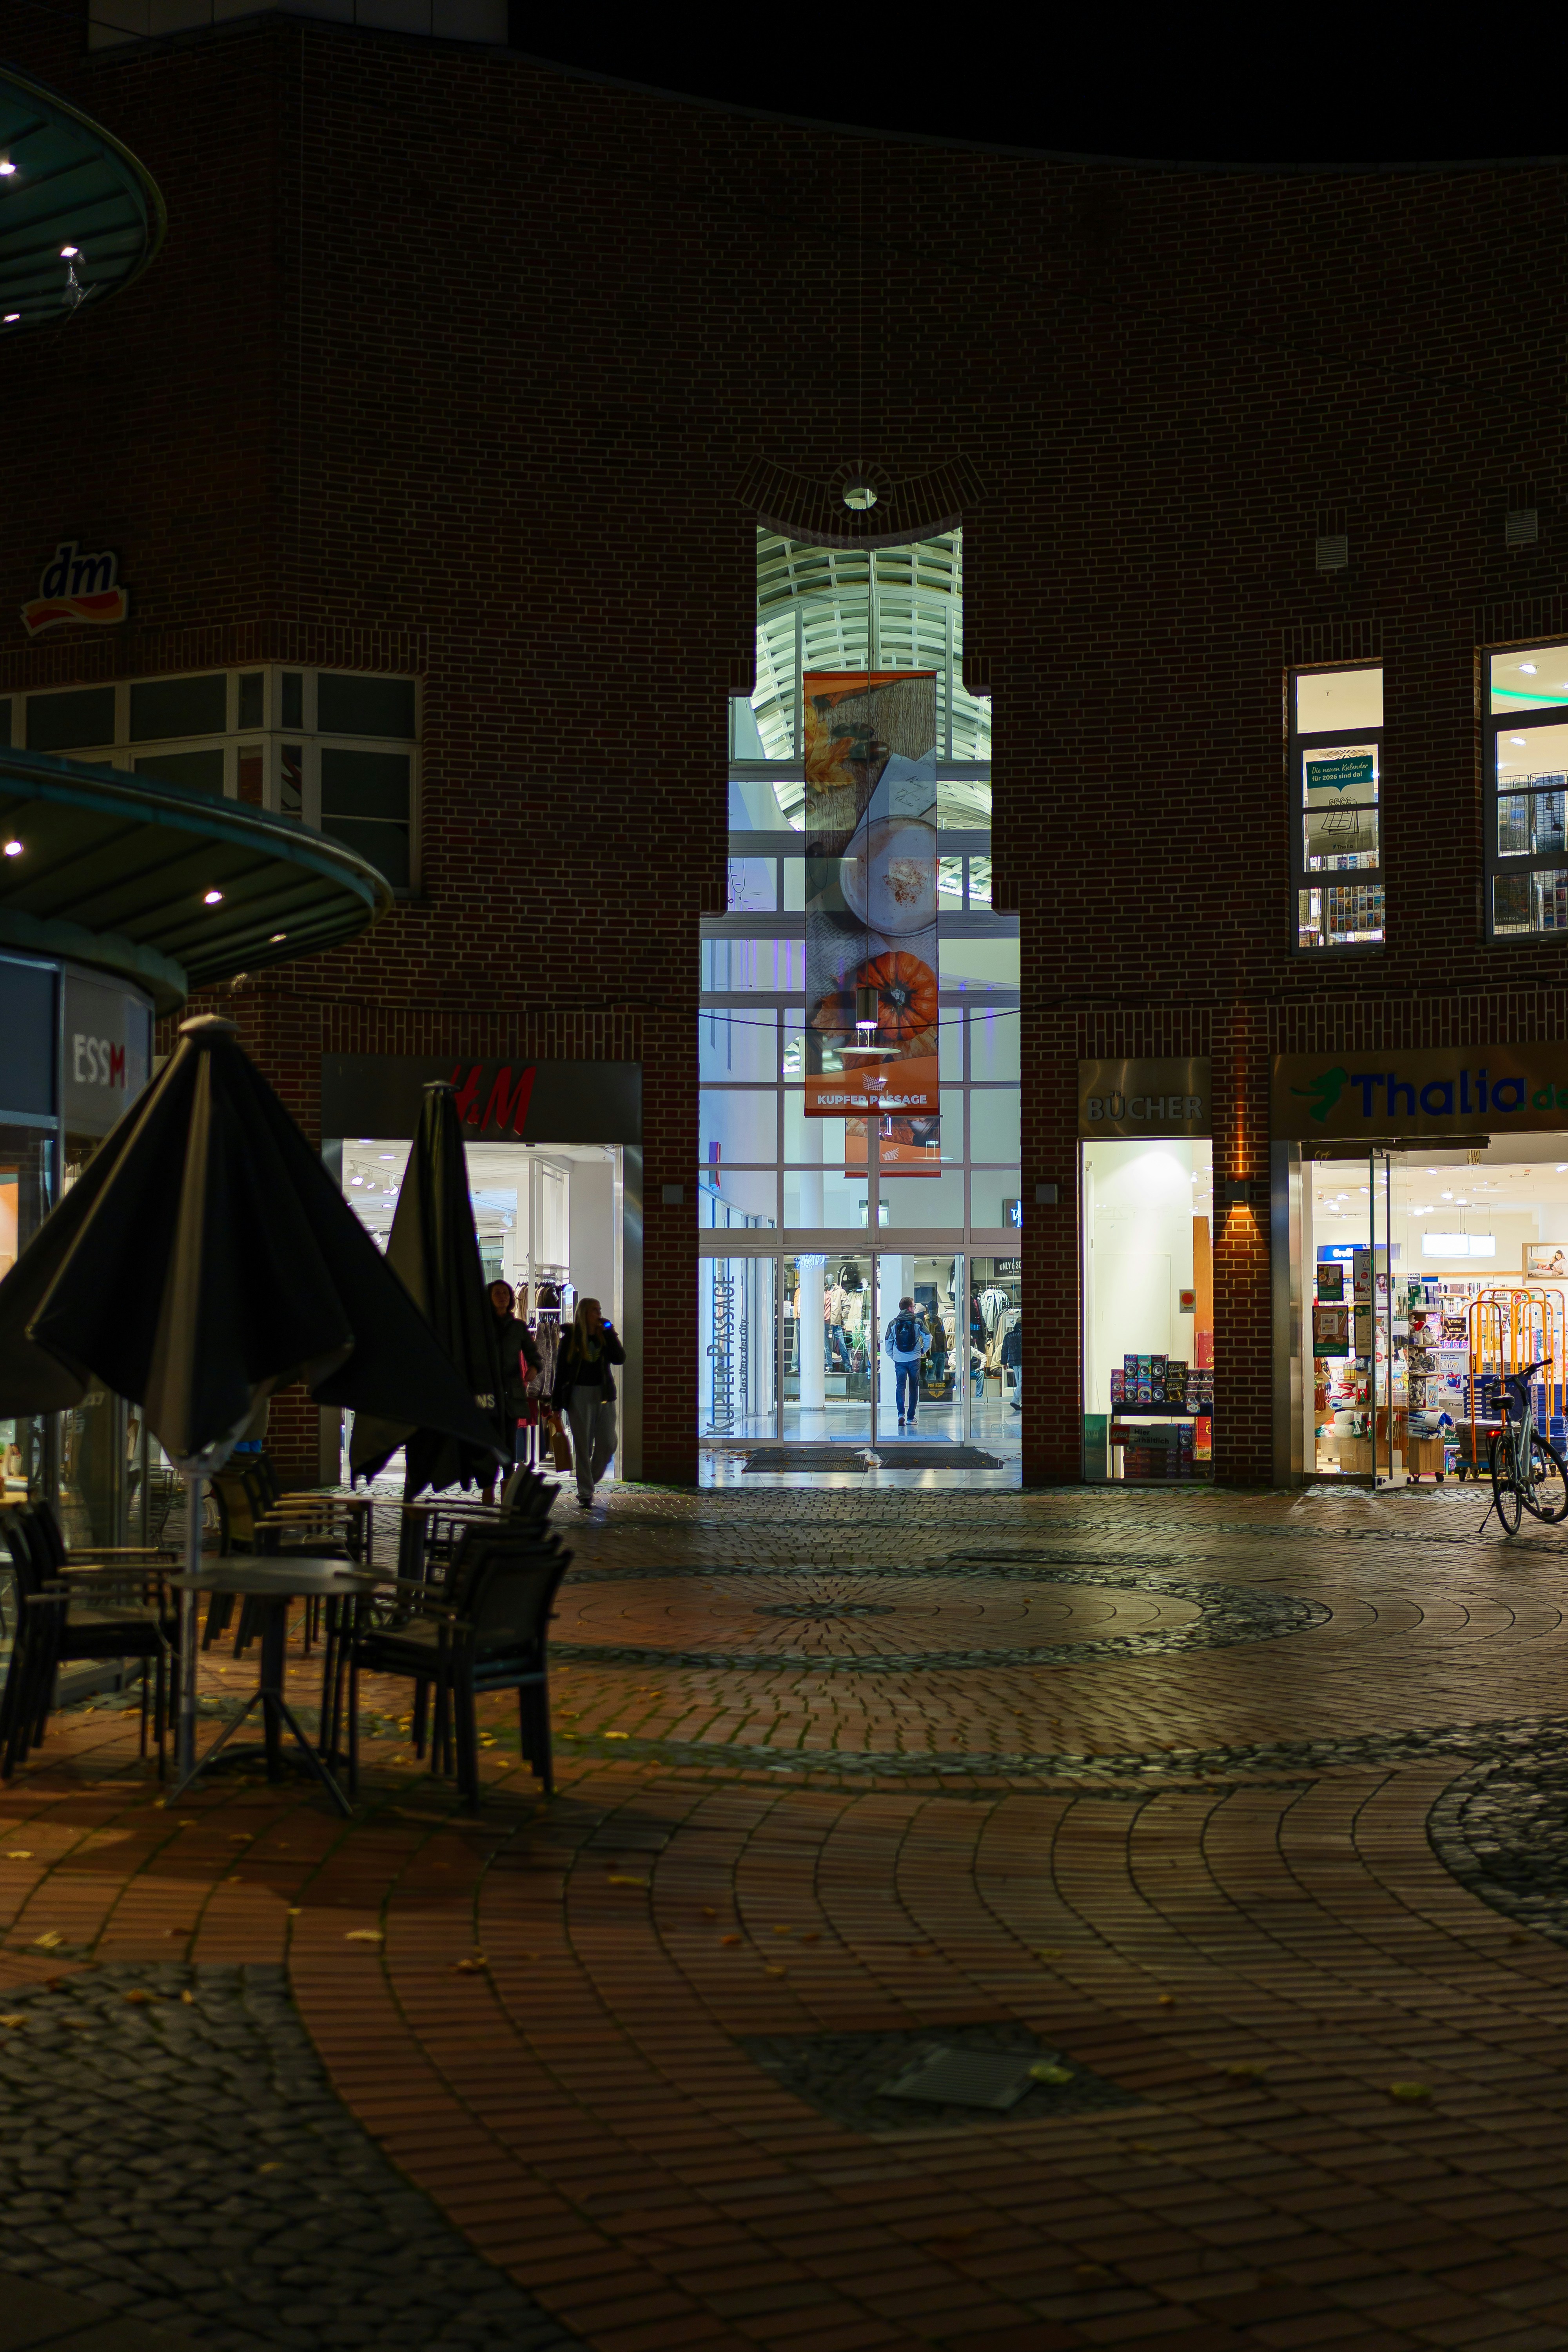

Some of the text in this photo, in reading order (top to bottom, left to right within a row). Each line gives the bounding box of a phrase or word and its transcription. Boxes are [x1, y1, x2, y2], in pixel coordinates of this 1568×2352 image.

[44, 546, 112, 598] dm
[1341, 762, 1368, 772] Kalender
[818, 1095, 927, 1104] KUPFER PASSAGE
[1087, 1091, 1203, 1121] BÜCHER
[999, 1261, 1011, 1270] ONLY
[739, 1319, 748, 1339] City
[706, 1276, 734, 1435] KUPFER PASSAGE
